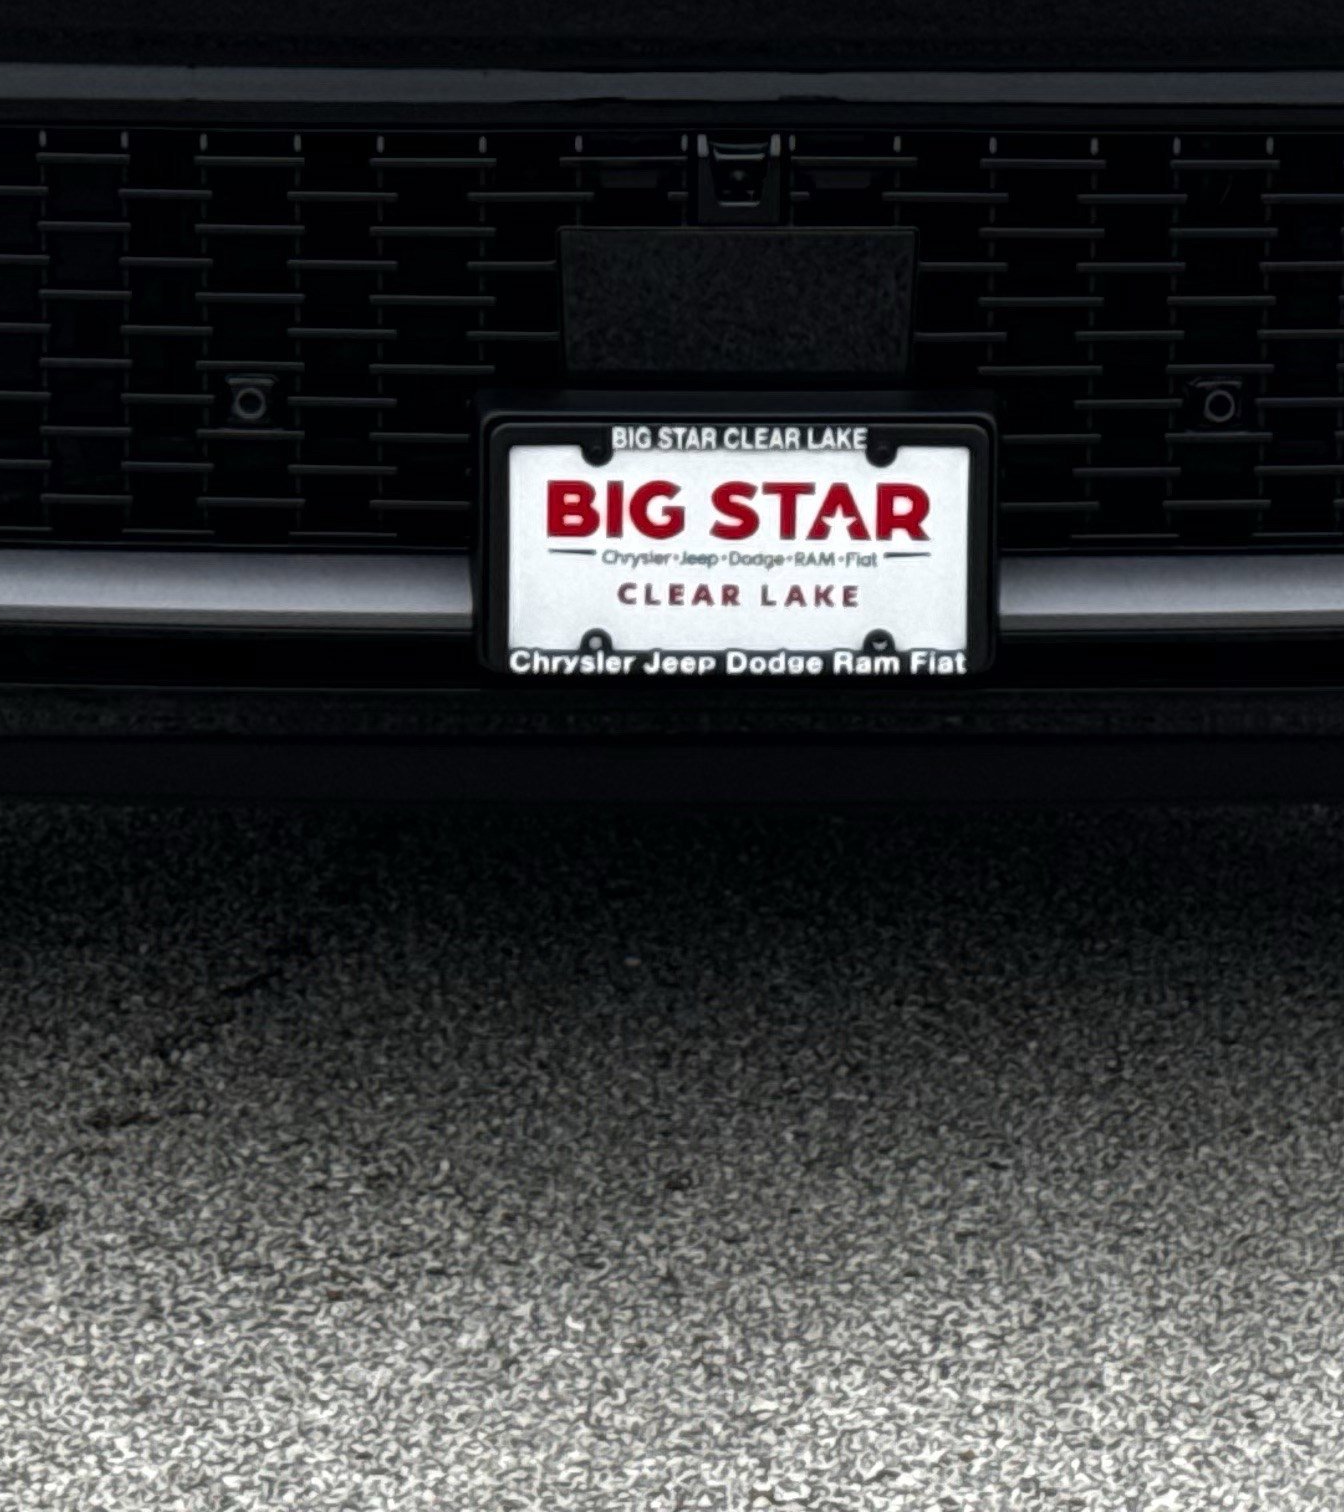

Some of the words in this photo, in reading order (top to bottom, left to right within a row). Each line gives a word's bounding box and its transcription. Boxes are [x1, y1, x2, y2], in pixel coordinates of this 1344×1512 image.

[611, 426, 652, 450] BIG
[657, 426, 717, 450] STAR
[723, 426, 800, 450] CLEAR
[807, 426, 868, 450] LAKE
[546, 480, 685, 539] BIG
[709, 481, 931, 541] STAR
[617, 582, 741, 606] CLEAR
[760, 583, 859, 608] LAKE
[509, 650, 635, 675] Chrysler
[643, 651, 716, 675] Jeep
[725, 651, 824, 675] Dodge
[833, 651, 900, 674] Ram
[910, 651, 968, 675] Fiat
